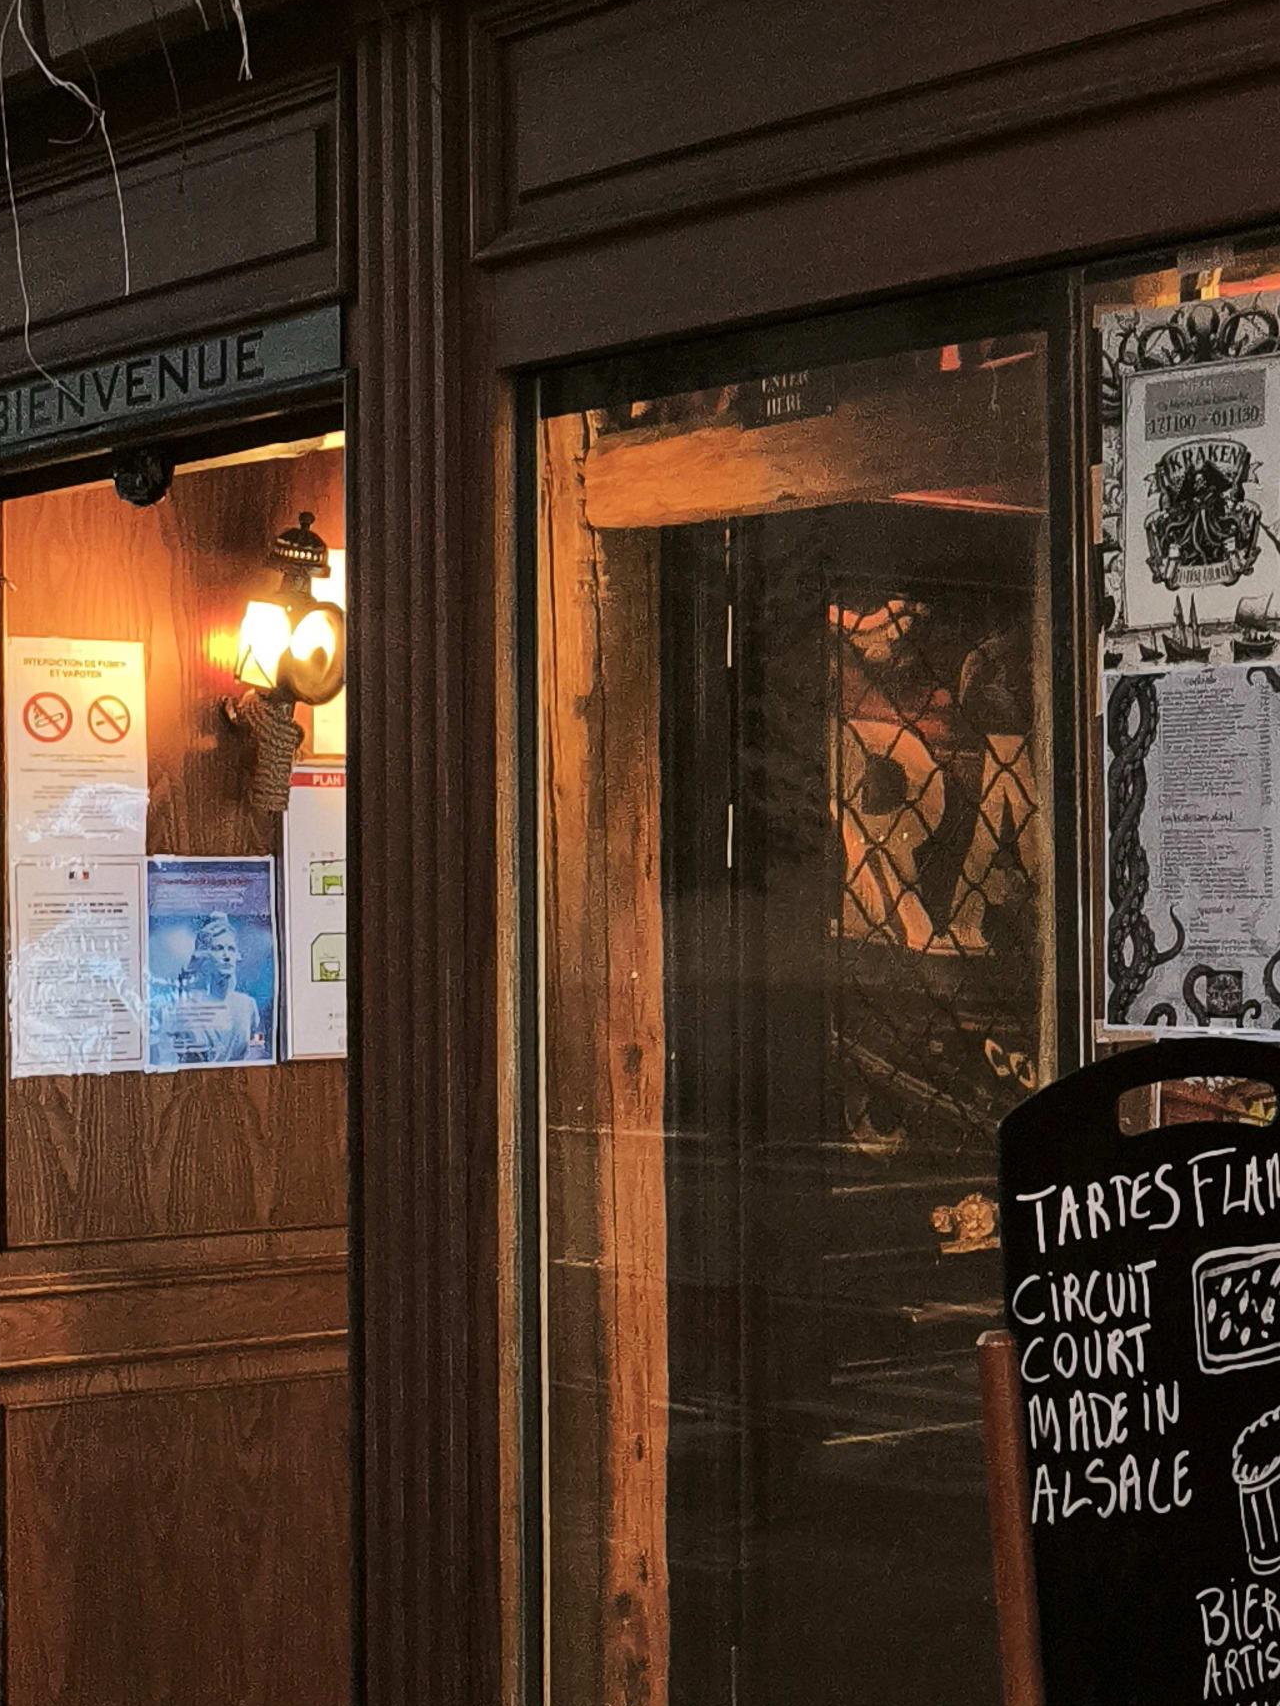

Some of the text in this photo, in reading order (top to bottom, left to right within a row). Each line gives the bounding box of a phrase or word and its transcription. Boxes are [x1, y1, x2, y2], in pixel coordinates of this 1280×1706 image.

[1168, 444, 1241, 473] KRAKEN
[1016, 1163, 1181, 1253] TARTES
[1021, 1323, 1151, 1383] COURT
[1028, 1389, 1128, 1453] MADE
[1031, 1450, 1192, 1525] ALSACE
